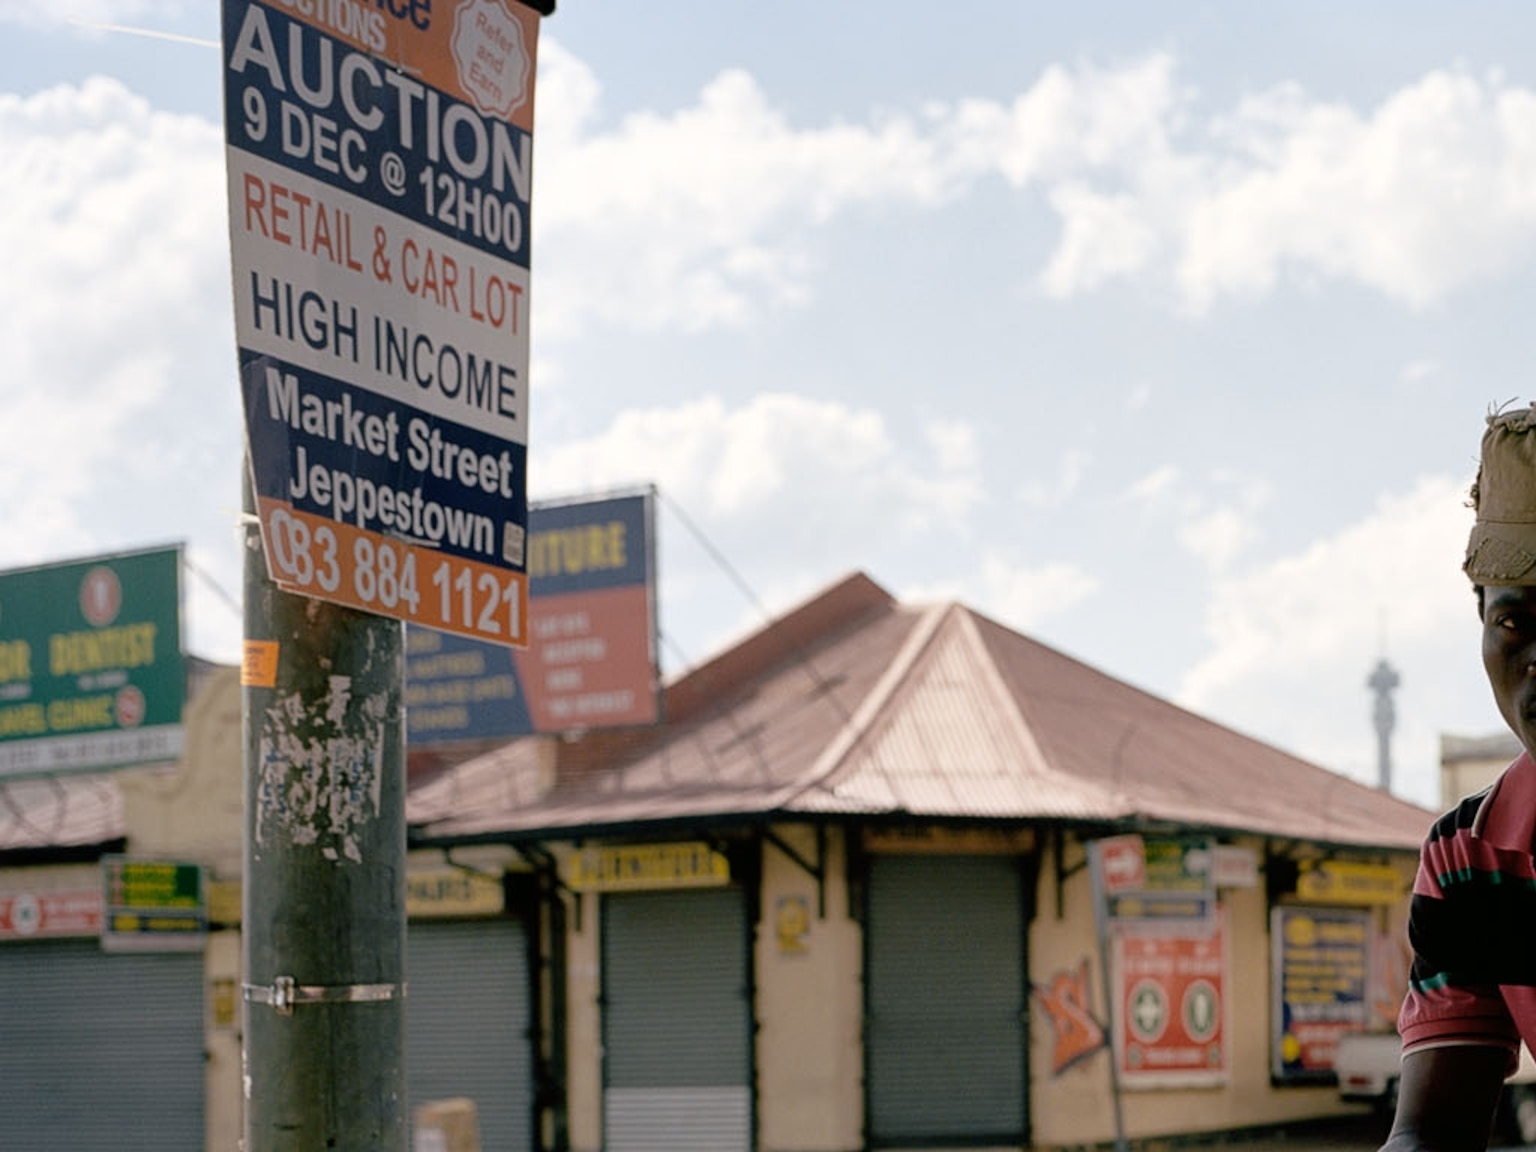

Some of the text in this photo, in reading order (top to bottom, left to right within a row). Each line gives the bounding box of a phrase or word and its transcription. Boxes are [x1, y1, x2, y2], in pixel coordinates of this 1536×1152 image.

[469, 62, 502, 100] Earn
[475, 11, 514, 54] Refer
[477, 45, 504, 76] and
[229, 6, 531, 204] AUCTION
[243, 86, 522, 252] 9 DEC @ 12H00
[243, 172, 523, 336] RETAIL & CAR LOT
[250, 270, 517, 420] HIGH INCOME
[264, 366, 513, 499] Market Street
[289, 445, 494, 555] Jeppestown
[353, 537, 420, 615] 884
[432, 562, 521, 639] 1121
[50, 623, 156, 676] DENTIST
[49, 697, 113, 730] CLINIC
